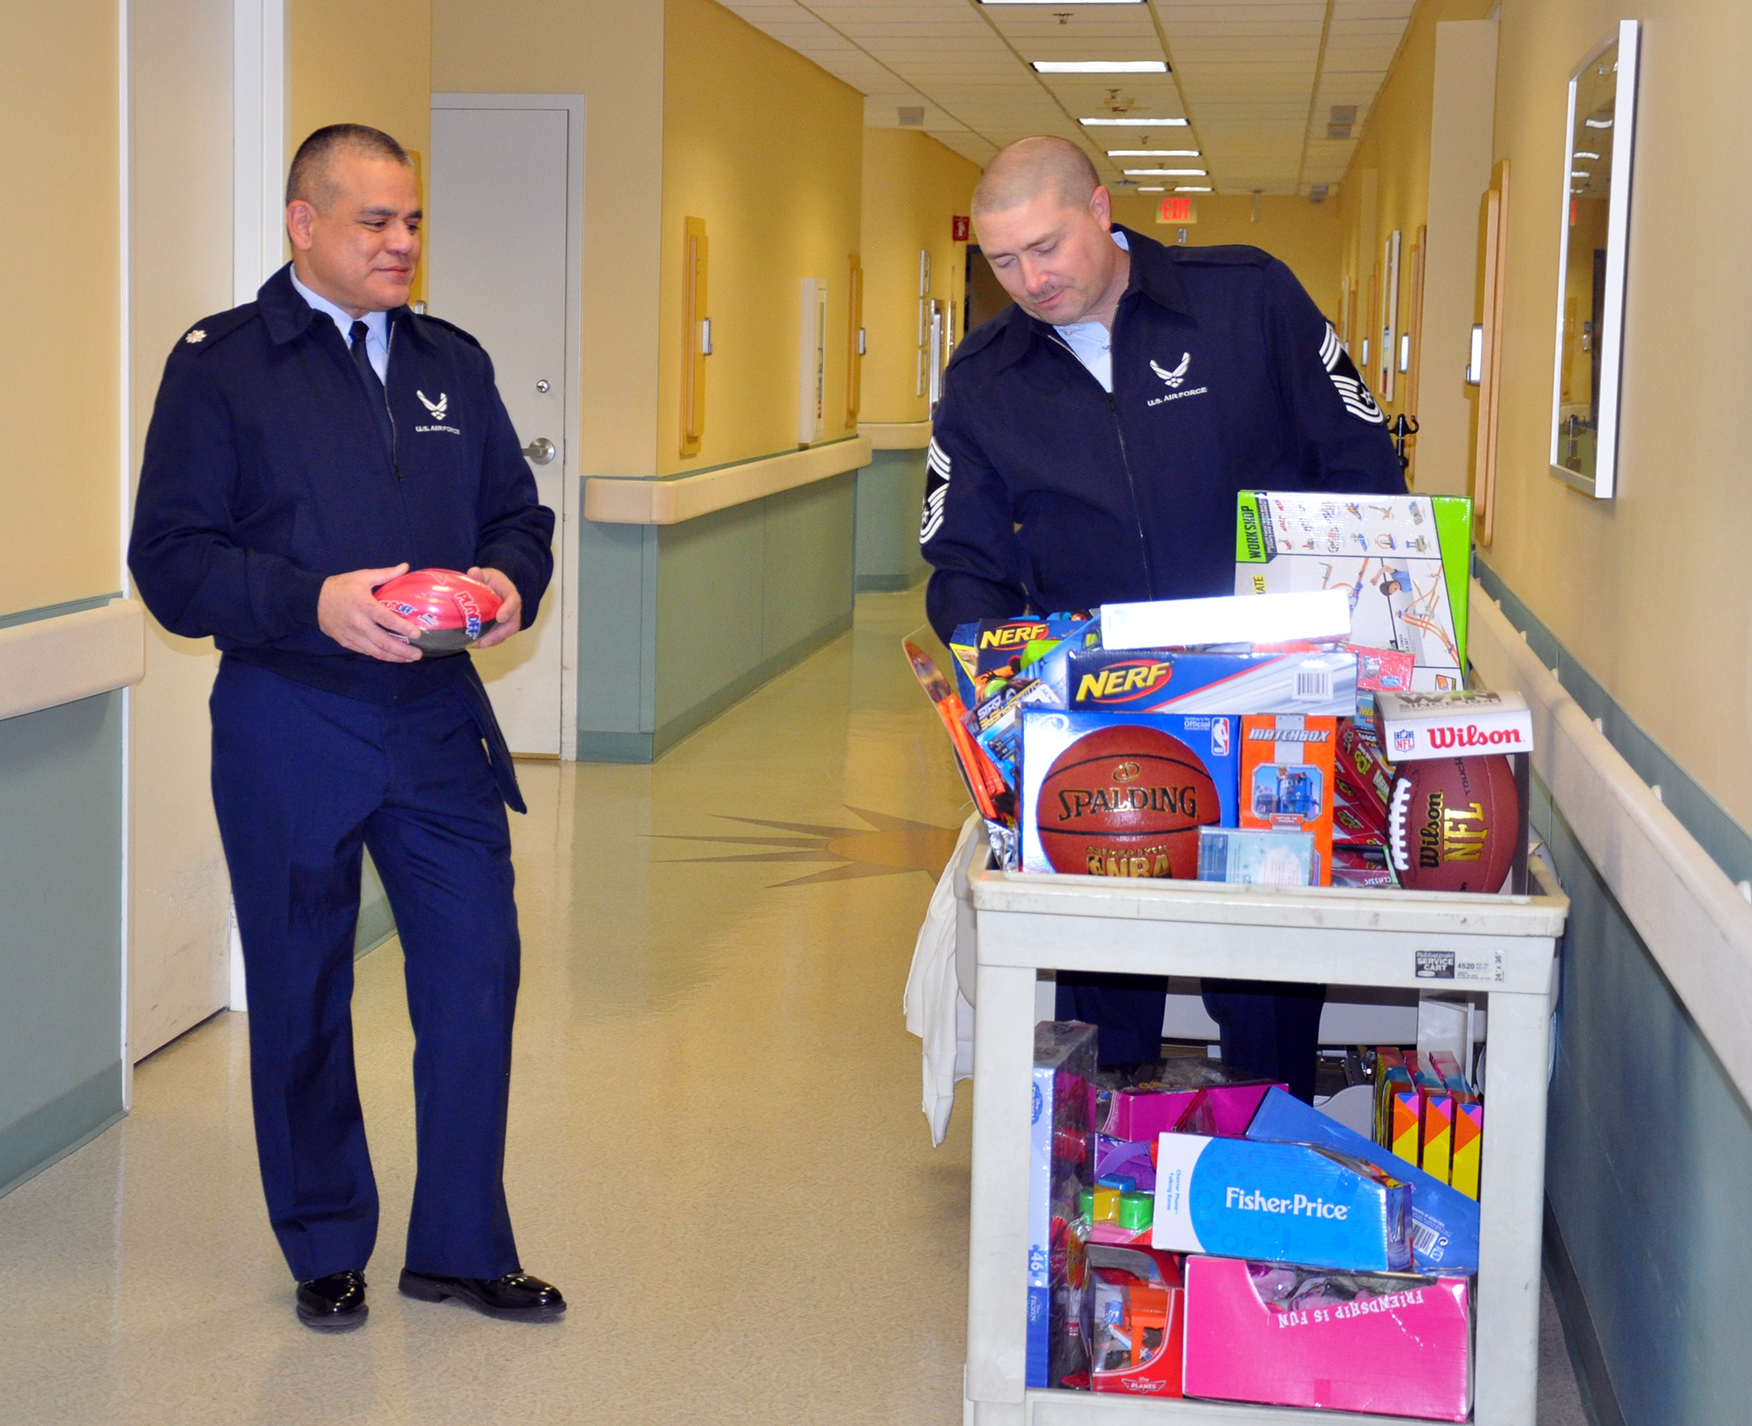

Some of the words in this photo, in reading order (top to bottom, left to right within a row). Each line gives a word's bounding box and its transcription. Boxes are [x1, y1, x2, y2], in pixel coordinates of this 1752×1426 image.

[1163, 198, 1191, 220] EXIT
[1147, 398, 1163, 406] U.S.
[1178, 387, 1208, 397] FORCE
[1241, 505, 1262, 559] WORKSHOP
[456, 592, 481, 639] PLAYOFF
[980, 624, 1046, 649] NERF
[1076, 662, 1170, 701] NERF
[1184, 720, 1210, 728] Official
[1248, 727, 1331, 743] MATCHBOX
[1427, 724, 1521, 749] Wilson
[1396, 738, 1413, 750] NFL
[1058, 786, 1197, 822] SPALDING
[1420, 791, 1444, 869] Wilson
[1443, 802, 1488, 862] NFL
[1106, 853, 1172, 879] NBA
[1417, 957, 1453, 965] SERVICE
[1225, 1186, 1348, 1221] Fisher-Price
[1031, 1252, 1044, 1271] 46
[1277, 1311, 1308, 1328] FUN
